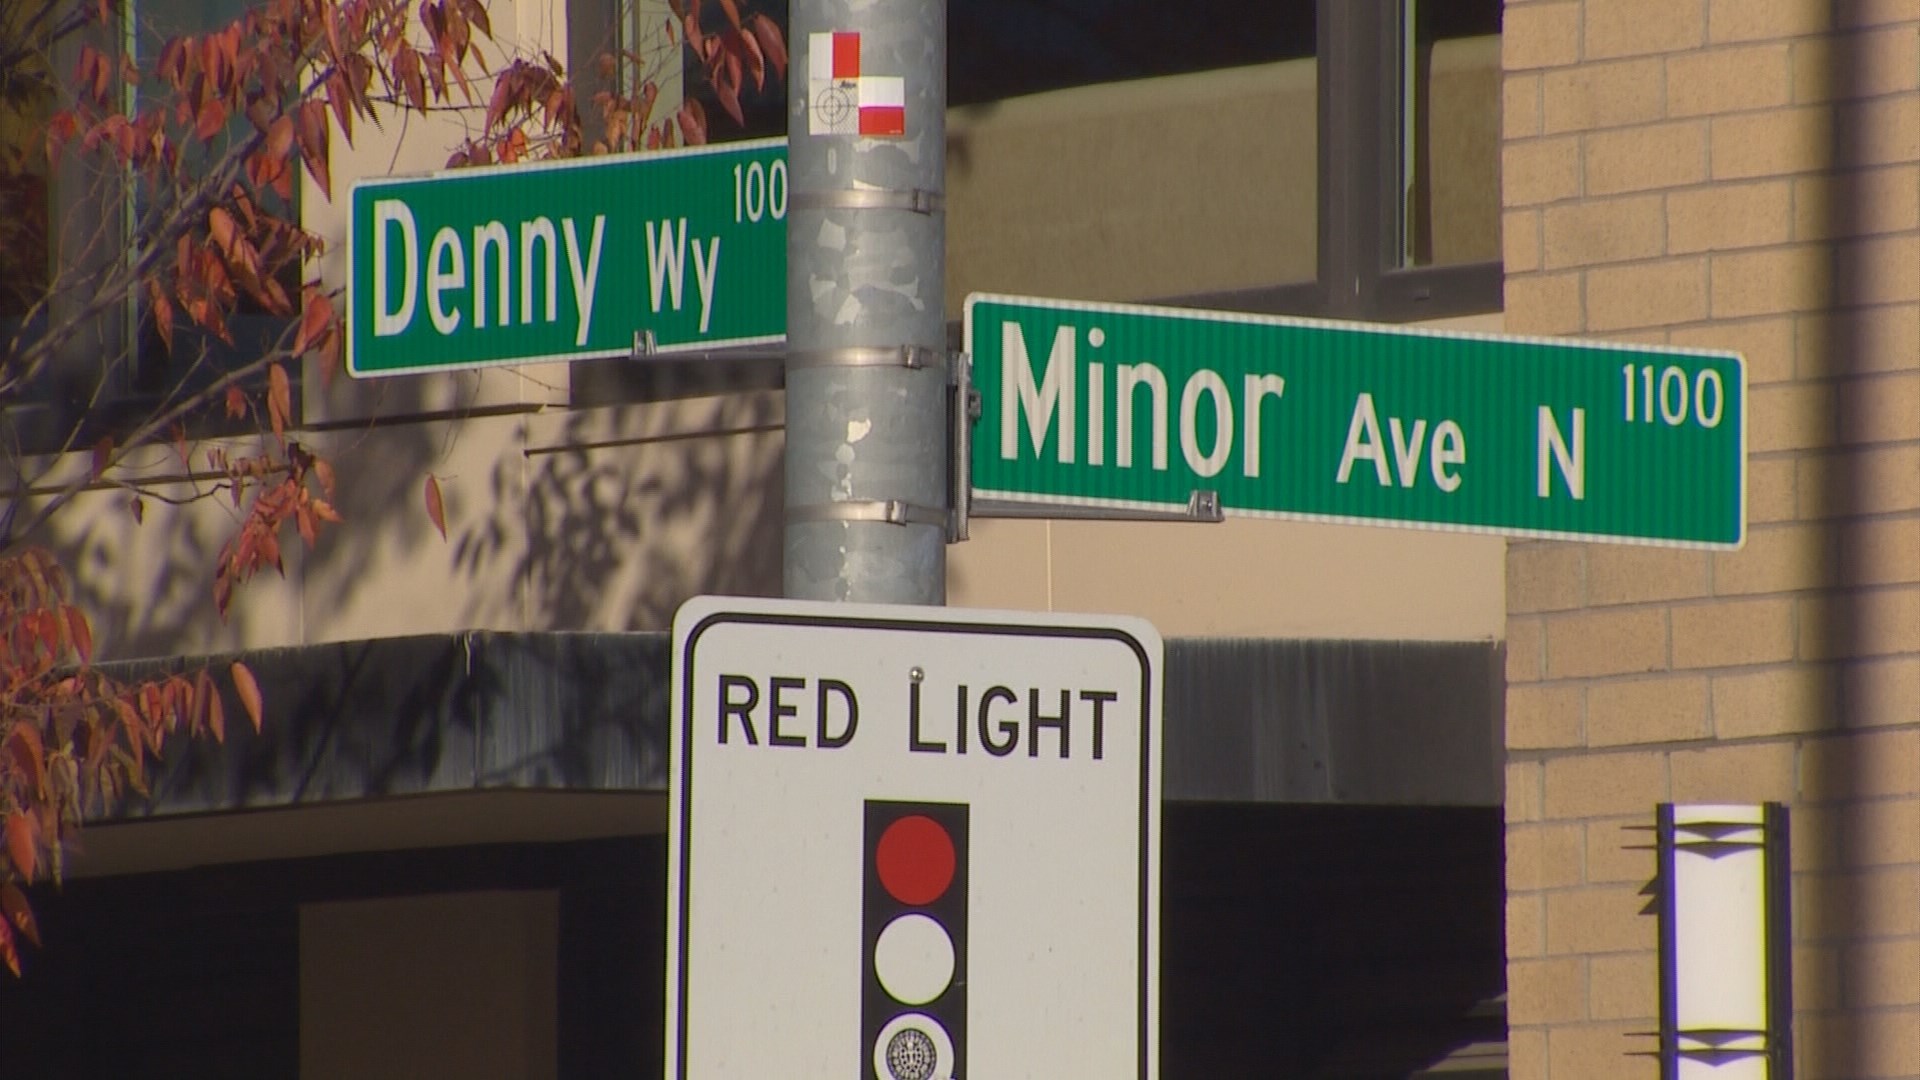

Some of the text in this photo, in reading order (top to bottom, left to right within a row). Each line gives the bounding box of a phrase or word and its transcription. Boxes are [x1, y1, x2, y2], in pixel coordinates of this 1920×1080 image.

[734, 158, 788, 223] 100
[373, 198, 720, 346] Denny Wy
[1001, 320, 1585, 500] Minor Ave N
[1622, 363, 1725, 428] 1100
[718, 674, 1117, 760] RED LIGHT
